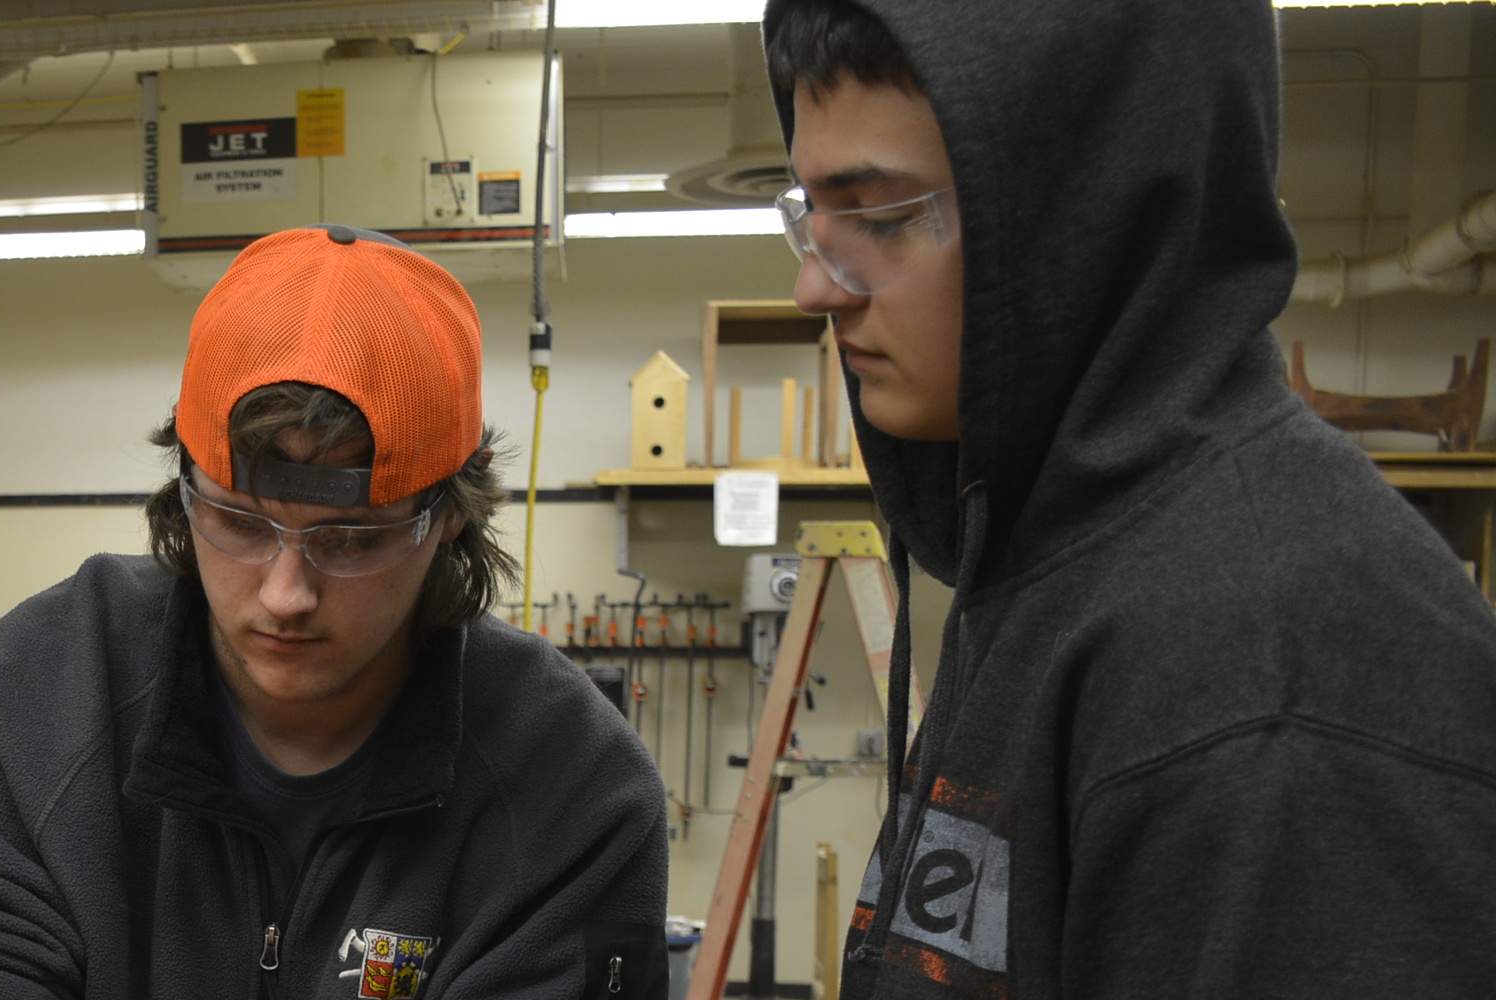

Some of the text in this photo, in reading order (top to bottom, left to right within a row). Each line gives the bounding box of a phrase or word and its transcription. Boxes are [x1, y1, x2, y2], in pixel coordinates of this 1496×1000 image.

[208, 132, 268, 151] JET
[145, 121, 158, 212] AIRGUARD
[194, 168, 283, 181] AIR FILTRATION
[216, 182, 262, 192] SYSTEM
